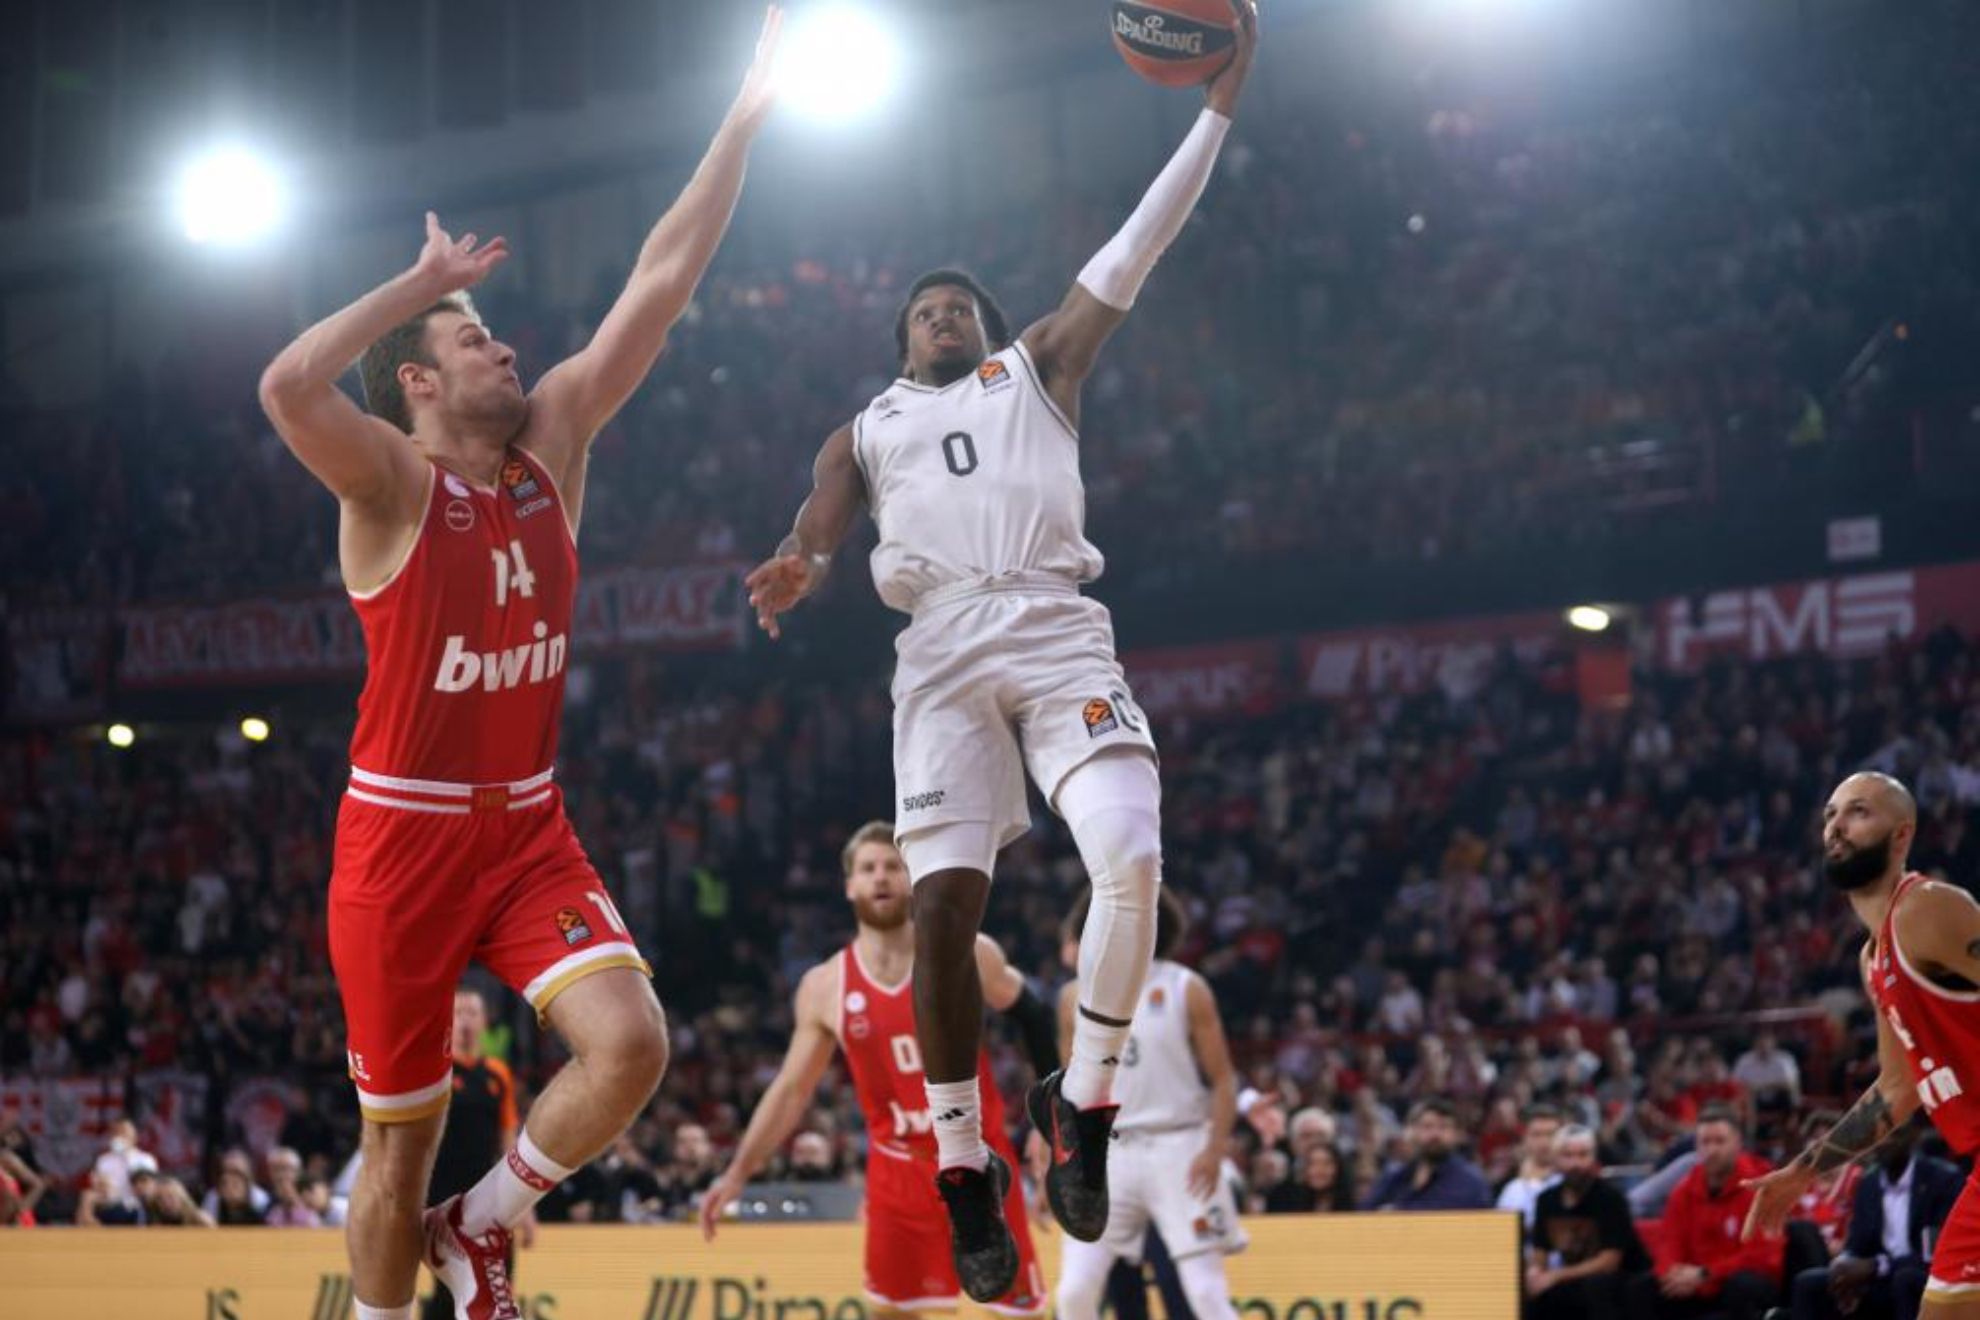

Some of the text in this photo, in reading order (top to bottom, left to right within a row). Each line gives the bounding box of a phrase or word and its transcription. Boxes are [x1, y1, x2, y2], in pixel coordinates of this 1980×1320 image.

[1116, 11, 1202, 53] SPALDING
[941, 431, 979, 477] 0
[491, 540, 536, 607] 14
[434, 620, 566, 693] bwin
[586, 890, 627, 934] 1
